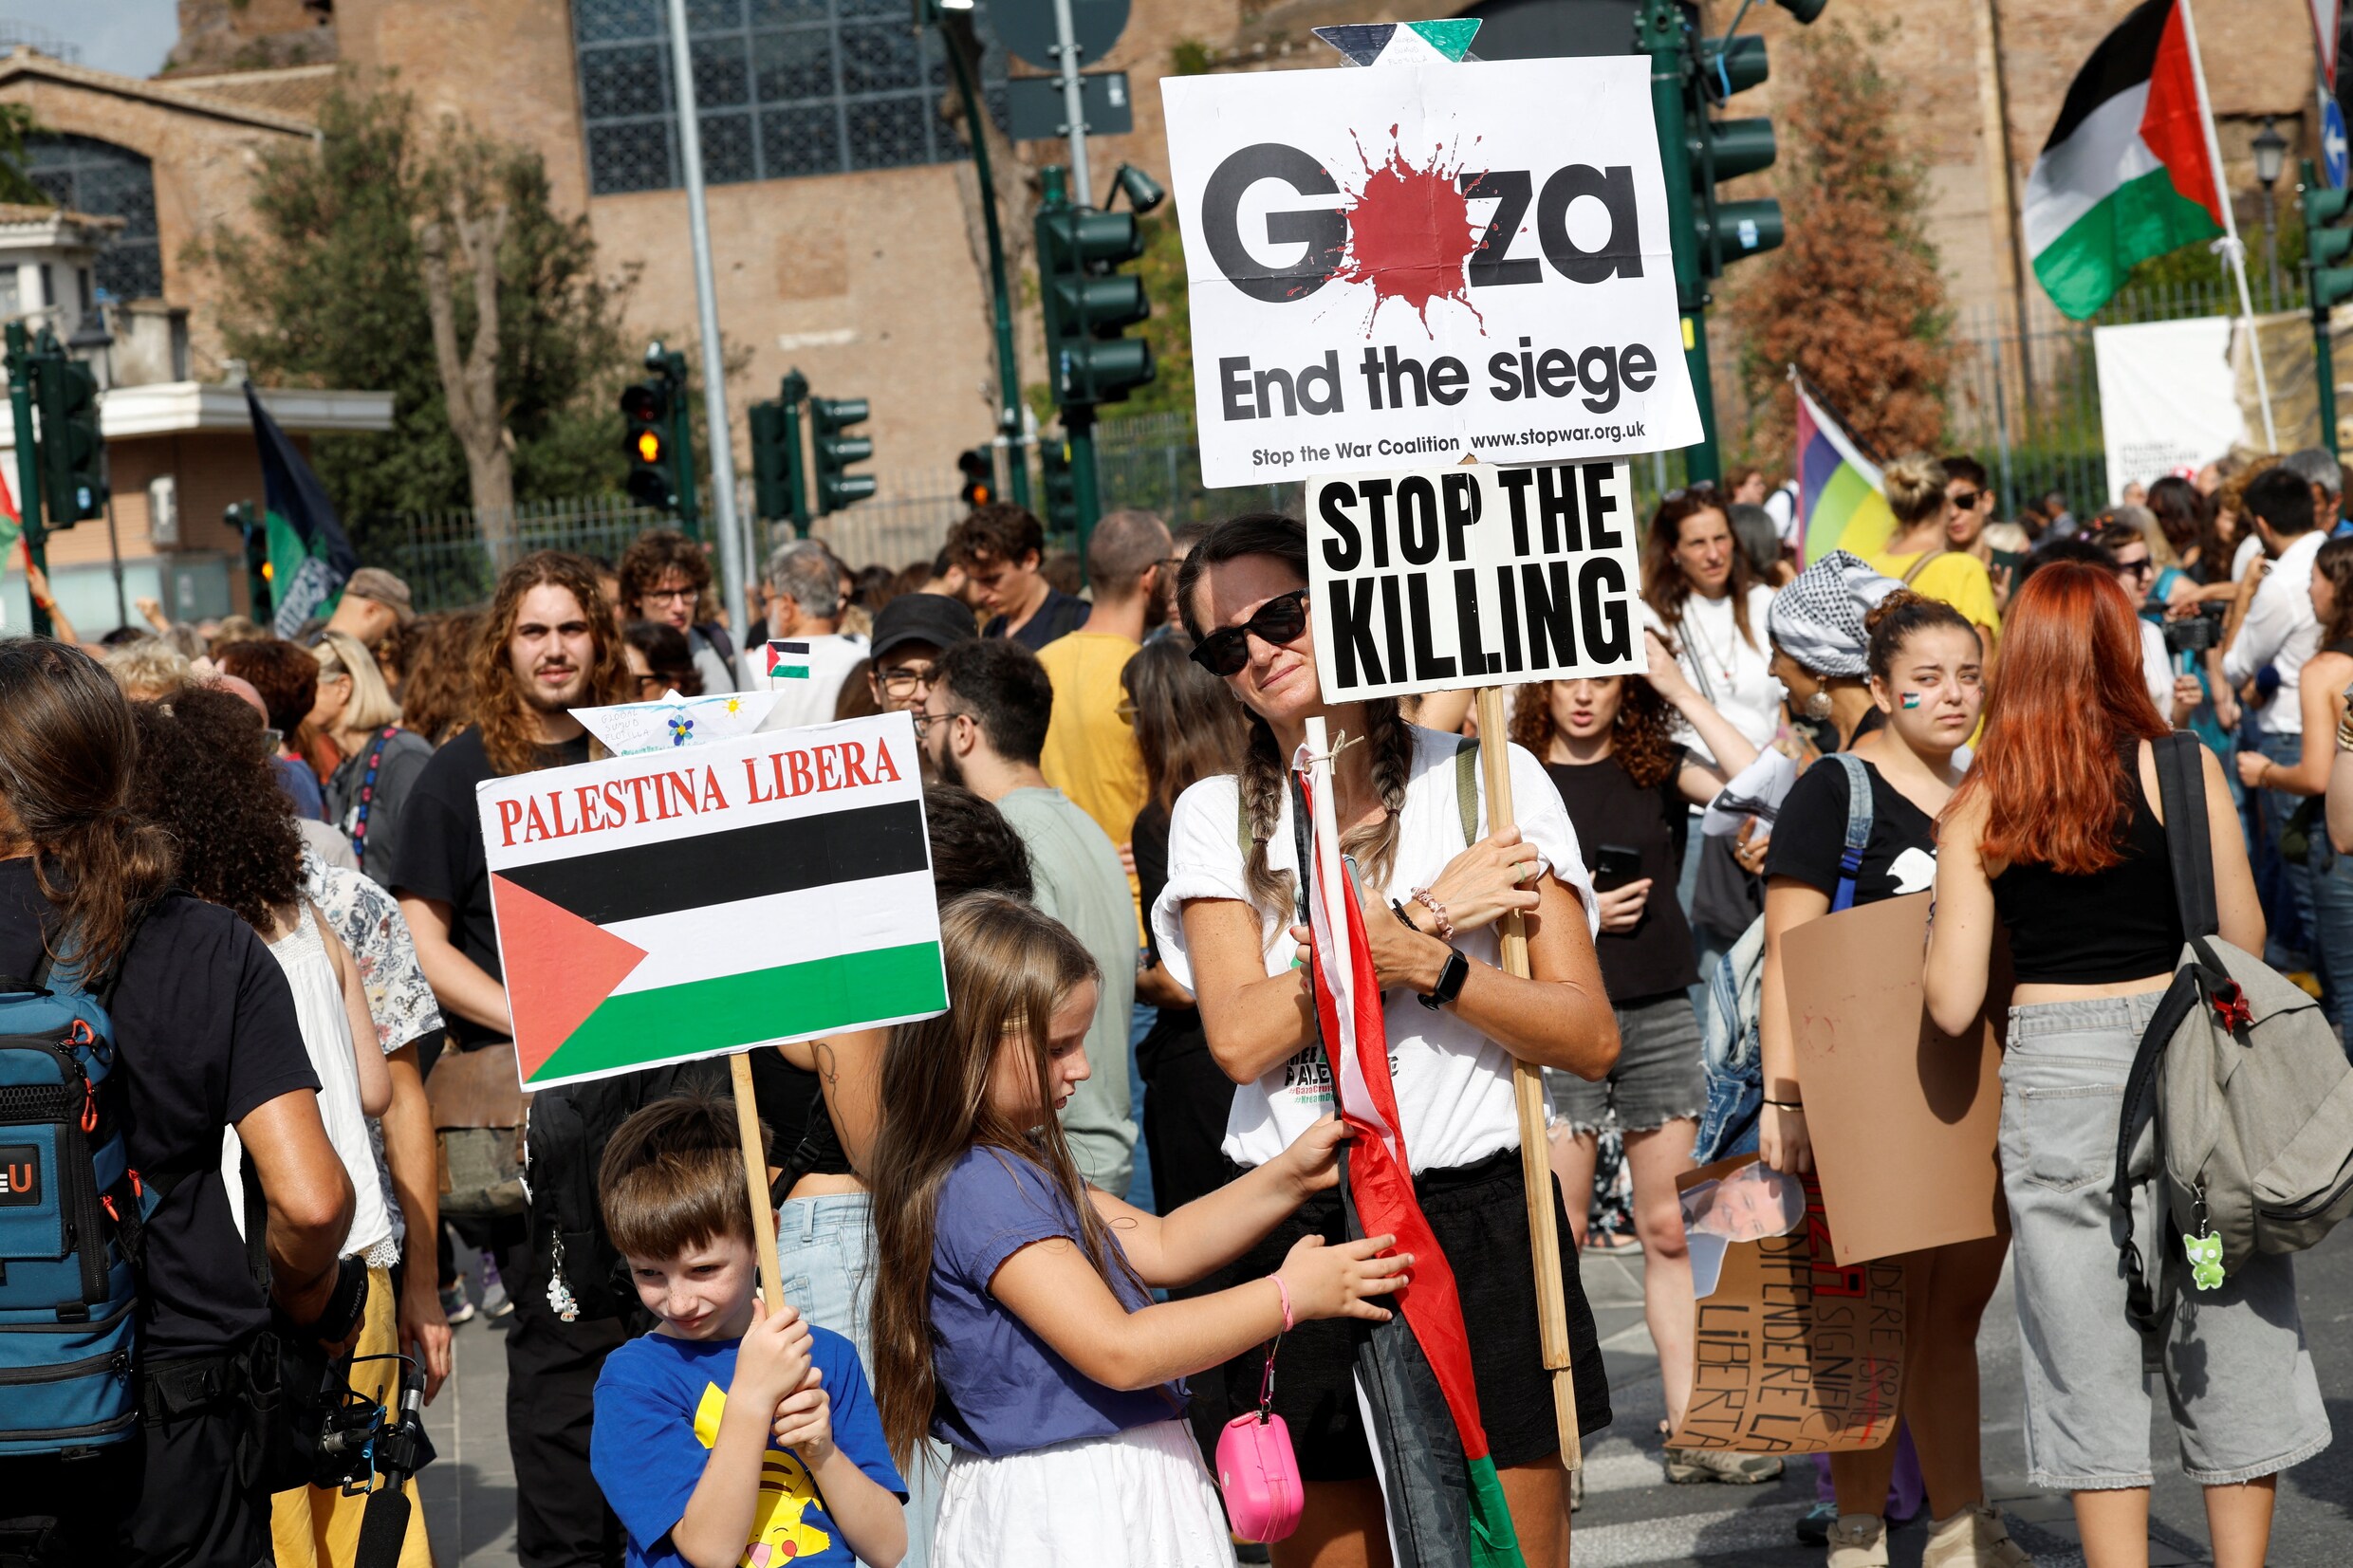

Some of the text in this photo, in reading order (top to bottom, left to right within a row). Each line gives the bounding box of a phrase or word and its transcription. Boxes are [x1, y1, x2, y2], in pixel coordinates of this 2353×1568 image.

[1202, 142, 1644, 304] Gza
[1218, 336, 1658, 421] End the siege
[1252, 421, 1646, 467] Stop the War Coalition www.stopwar.org.uk
[1318, 462, 1623, 572] STOP THE
[1328, 557, 1632, 689] KILLING
[495, 736, 902, 847] PALESTINA LIBERA
[349, 1280, 364, 1319] Canon
[1735, 1235, 1812, 1452] DIFENDERE LA
[1868, 1259, 1904, 1346] NDERE
